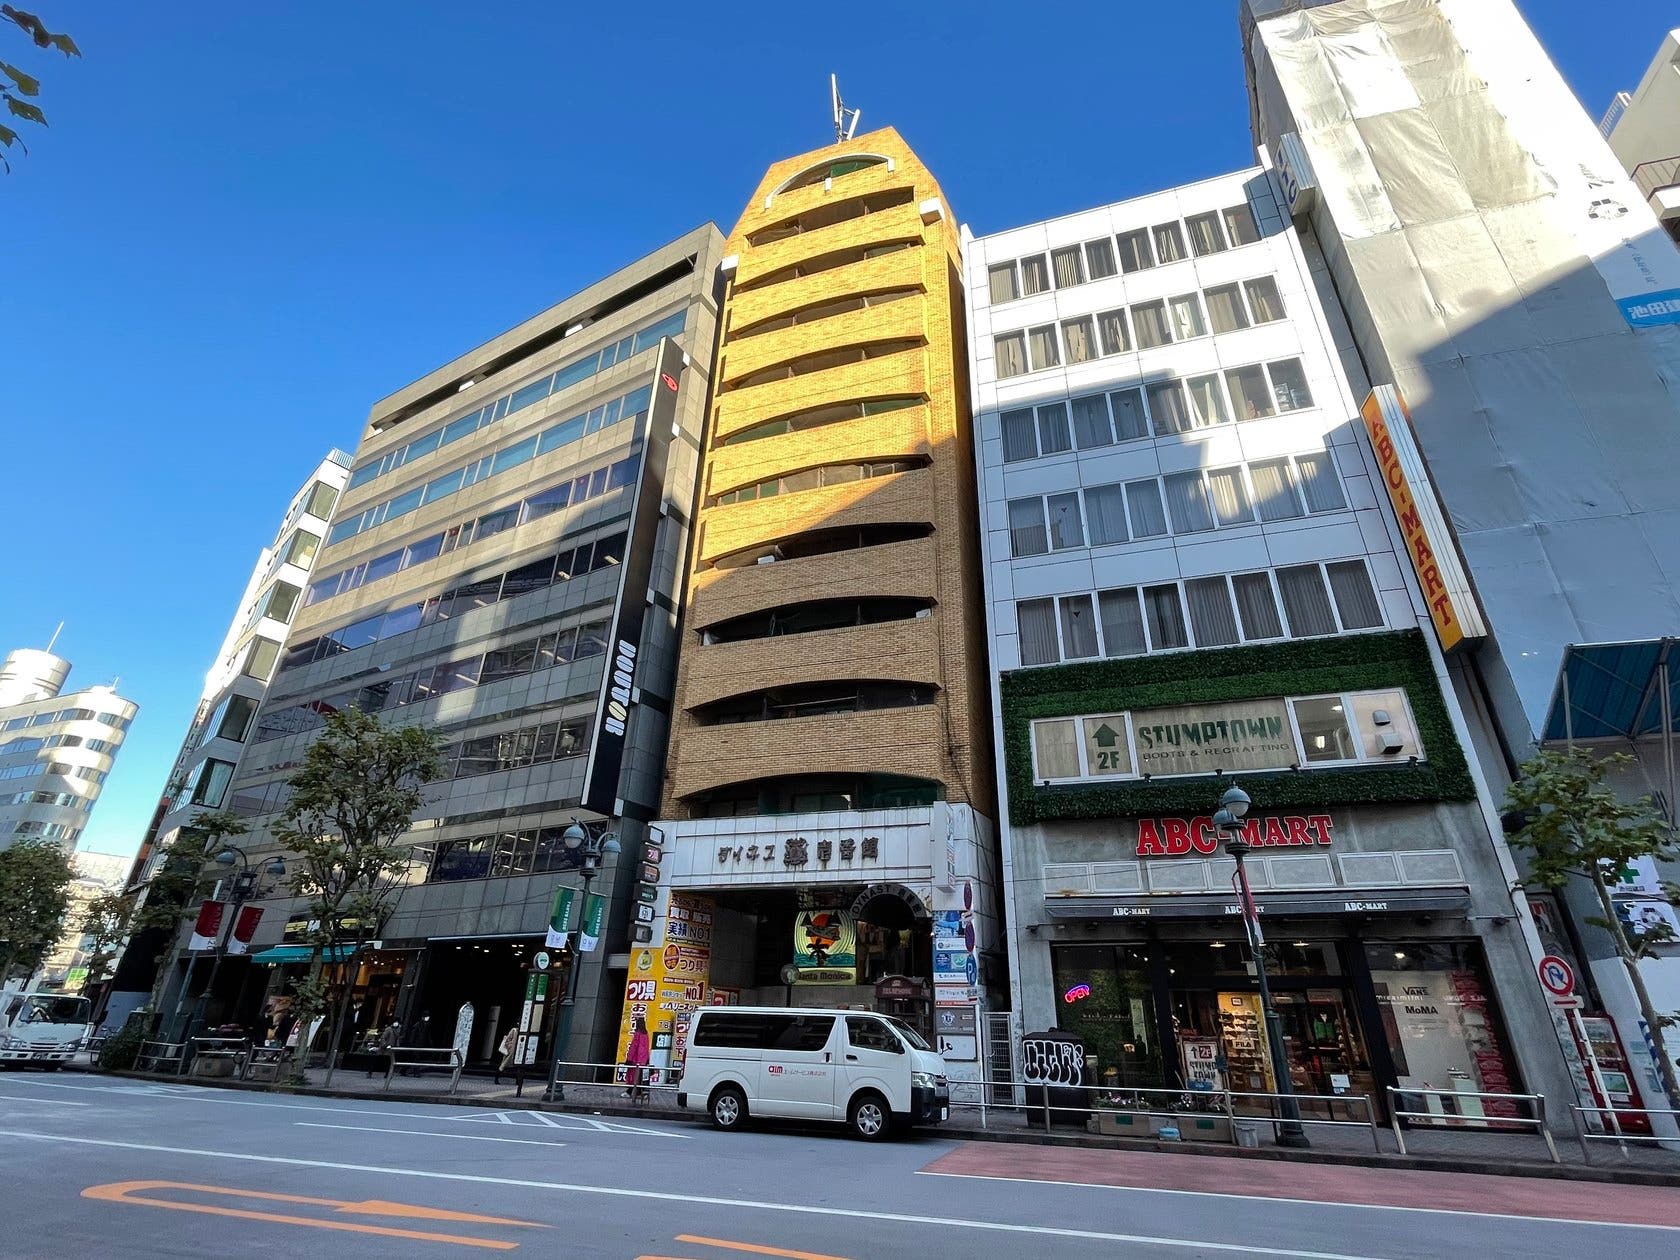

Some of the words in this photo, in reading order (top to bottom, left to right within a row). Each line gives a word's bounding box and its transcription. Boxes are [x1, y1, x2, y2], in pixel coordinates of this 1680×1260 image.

[1370, 413, 1452, 627] ABC-MART
[604, 638, 637, 738] DOUTOR
[1138, 716, 1282, 749] STUMPTOWN
[1096, 750, 1120, 770] 2F
[1143, 750, 1186, 760] BOOTS
[1204, 743, 1290, 755] RECRAFTING
[1136, 814, 1333, 856] ABC-MART
[1112, 906, 1151, 915] ABC-MART
[1344, 901, 1388, 912] ABC-MART
[627, 980, 656, 1000] つり具
[1064, 988, 1090, 1004] OPEN
[1405, 1006, 1439, 1015] MoMA
[1199, 1047, 1212, 1057] 2F
